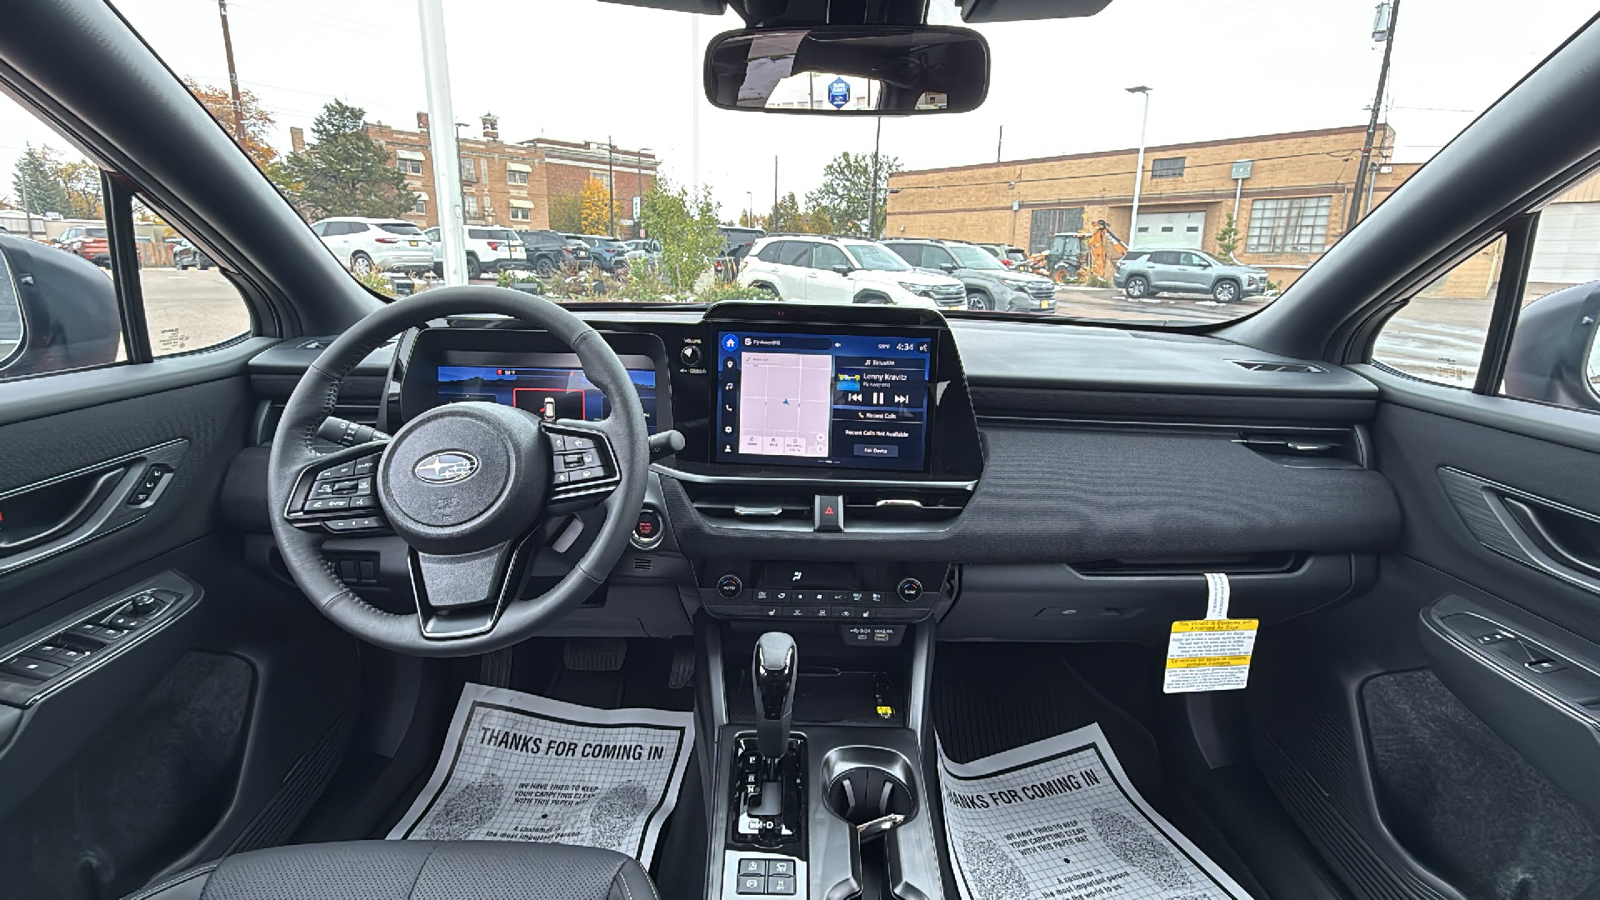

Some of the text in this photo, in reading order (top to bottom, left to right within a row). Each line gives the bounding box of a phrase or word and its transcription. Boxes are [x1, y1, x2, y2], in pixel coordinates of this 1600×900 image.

[863, 373, 883, 381] Lenny
[479, 727, 664, 761] THANKS FOR COMING IN
[989, 790, 1023, 806] FOR
[1022, 775, 1082, 800] COMING
[1080, 769, 1100, 787] IN
[1010, 828, 1086, 848] YOUR CARPETING CLEAN
[1016, 830, 1033, 838] HAVE
[1033, 826, 1053, 834] TRIED
[1019, 847, 1038, 856] WITH
[1037, 843, 1054, 852] THIS
[1053, 838, 1075, 849] PAPER
[1055, 886, 1073, 895] most
[1072, 878, 1105, 889] important
[1106, 871, 1130, 883] person
[1064, 871, 1093, 882] customer
[1084, 888, 1104, 898] world
